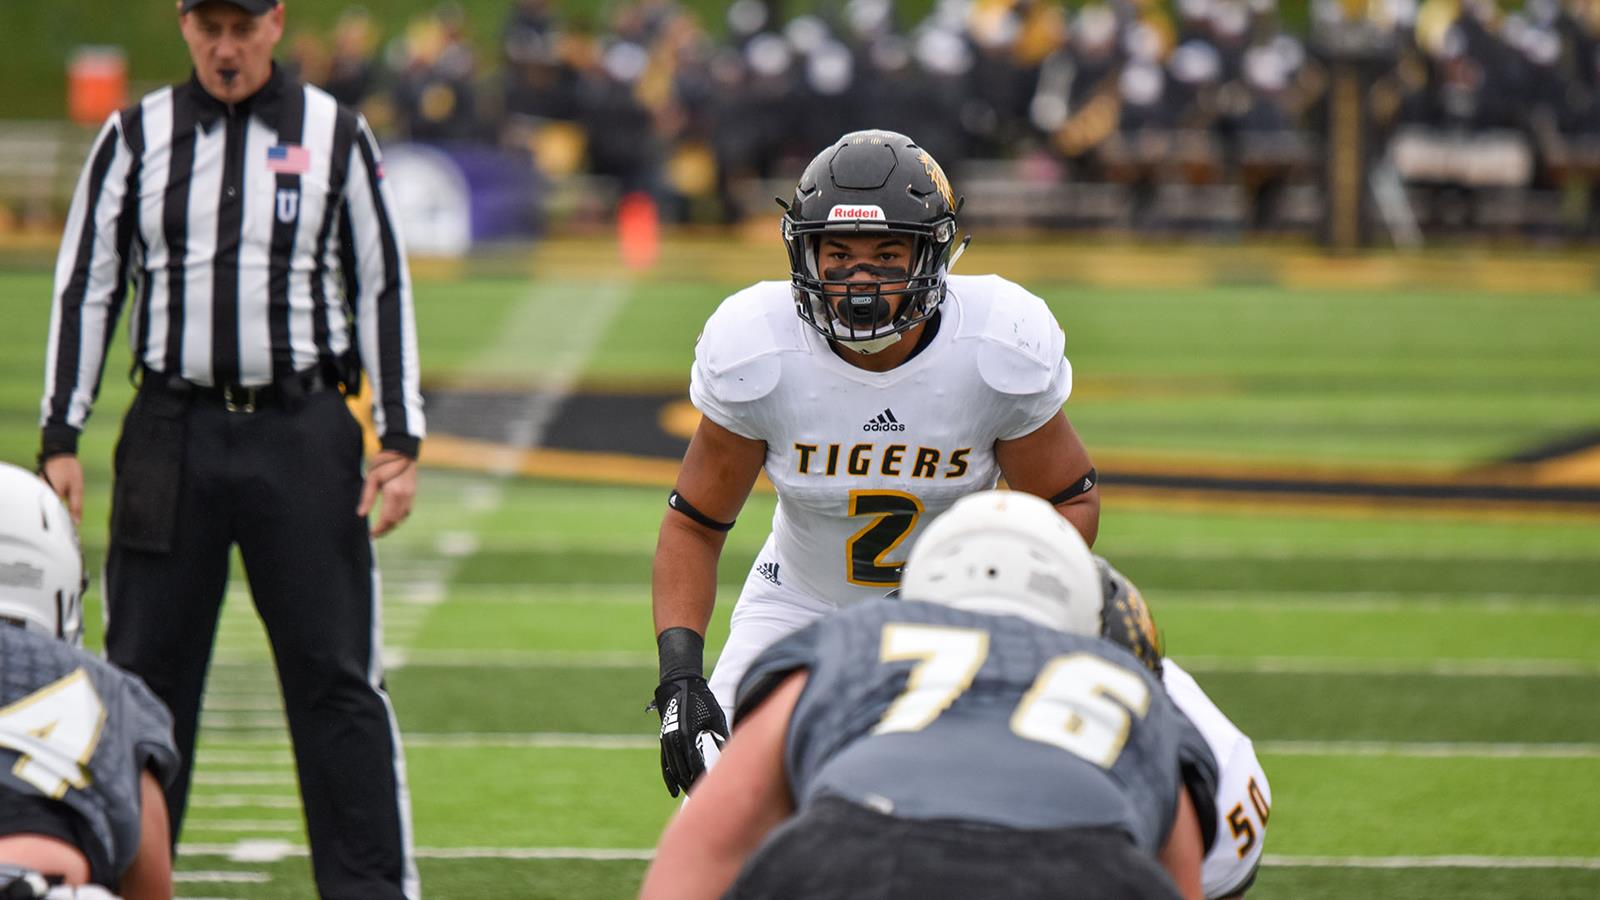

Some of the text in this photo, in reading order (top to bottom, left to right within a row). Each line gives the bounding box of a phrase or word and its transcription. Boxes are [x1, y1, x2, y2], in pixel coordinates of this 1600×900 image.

[276, 189, 299, 223] U
[834, 207, 879, 219] Riddell
[863, 422, 906, 432] adidas
[793, 442, 972, 480] TIGERS
[845, 488, 926, 588] 2
[872, 622, 1151, 769] 76
[1224, 773, 1270, 862] 50
